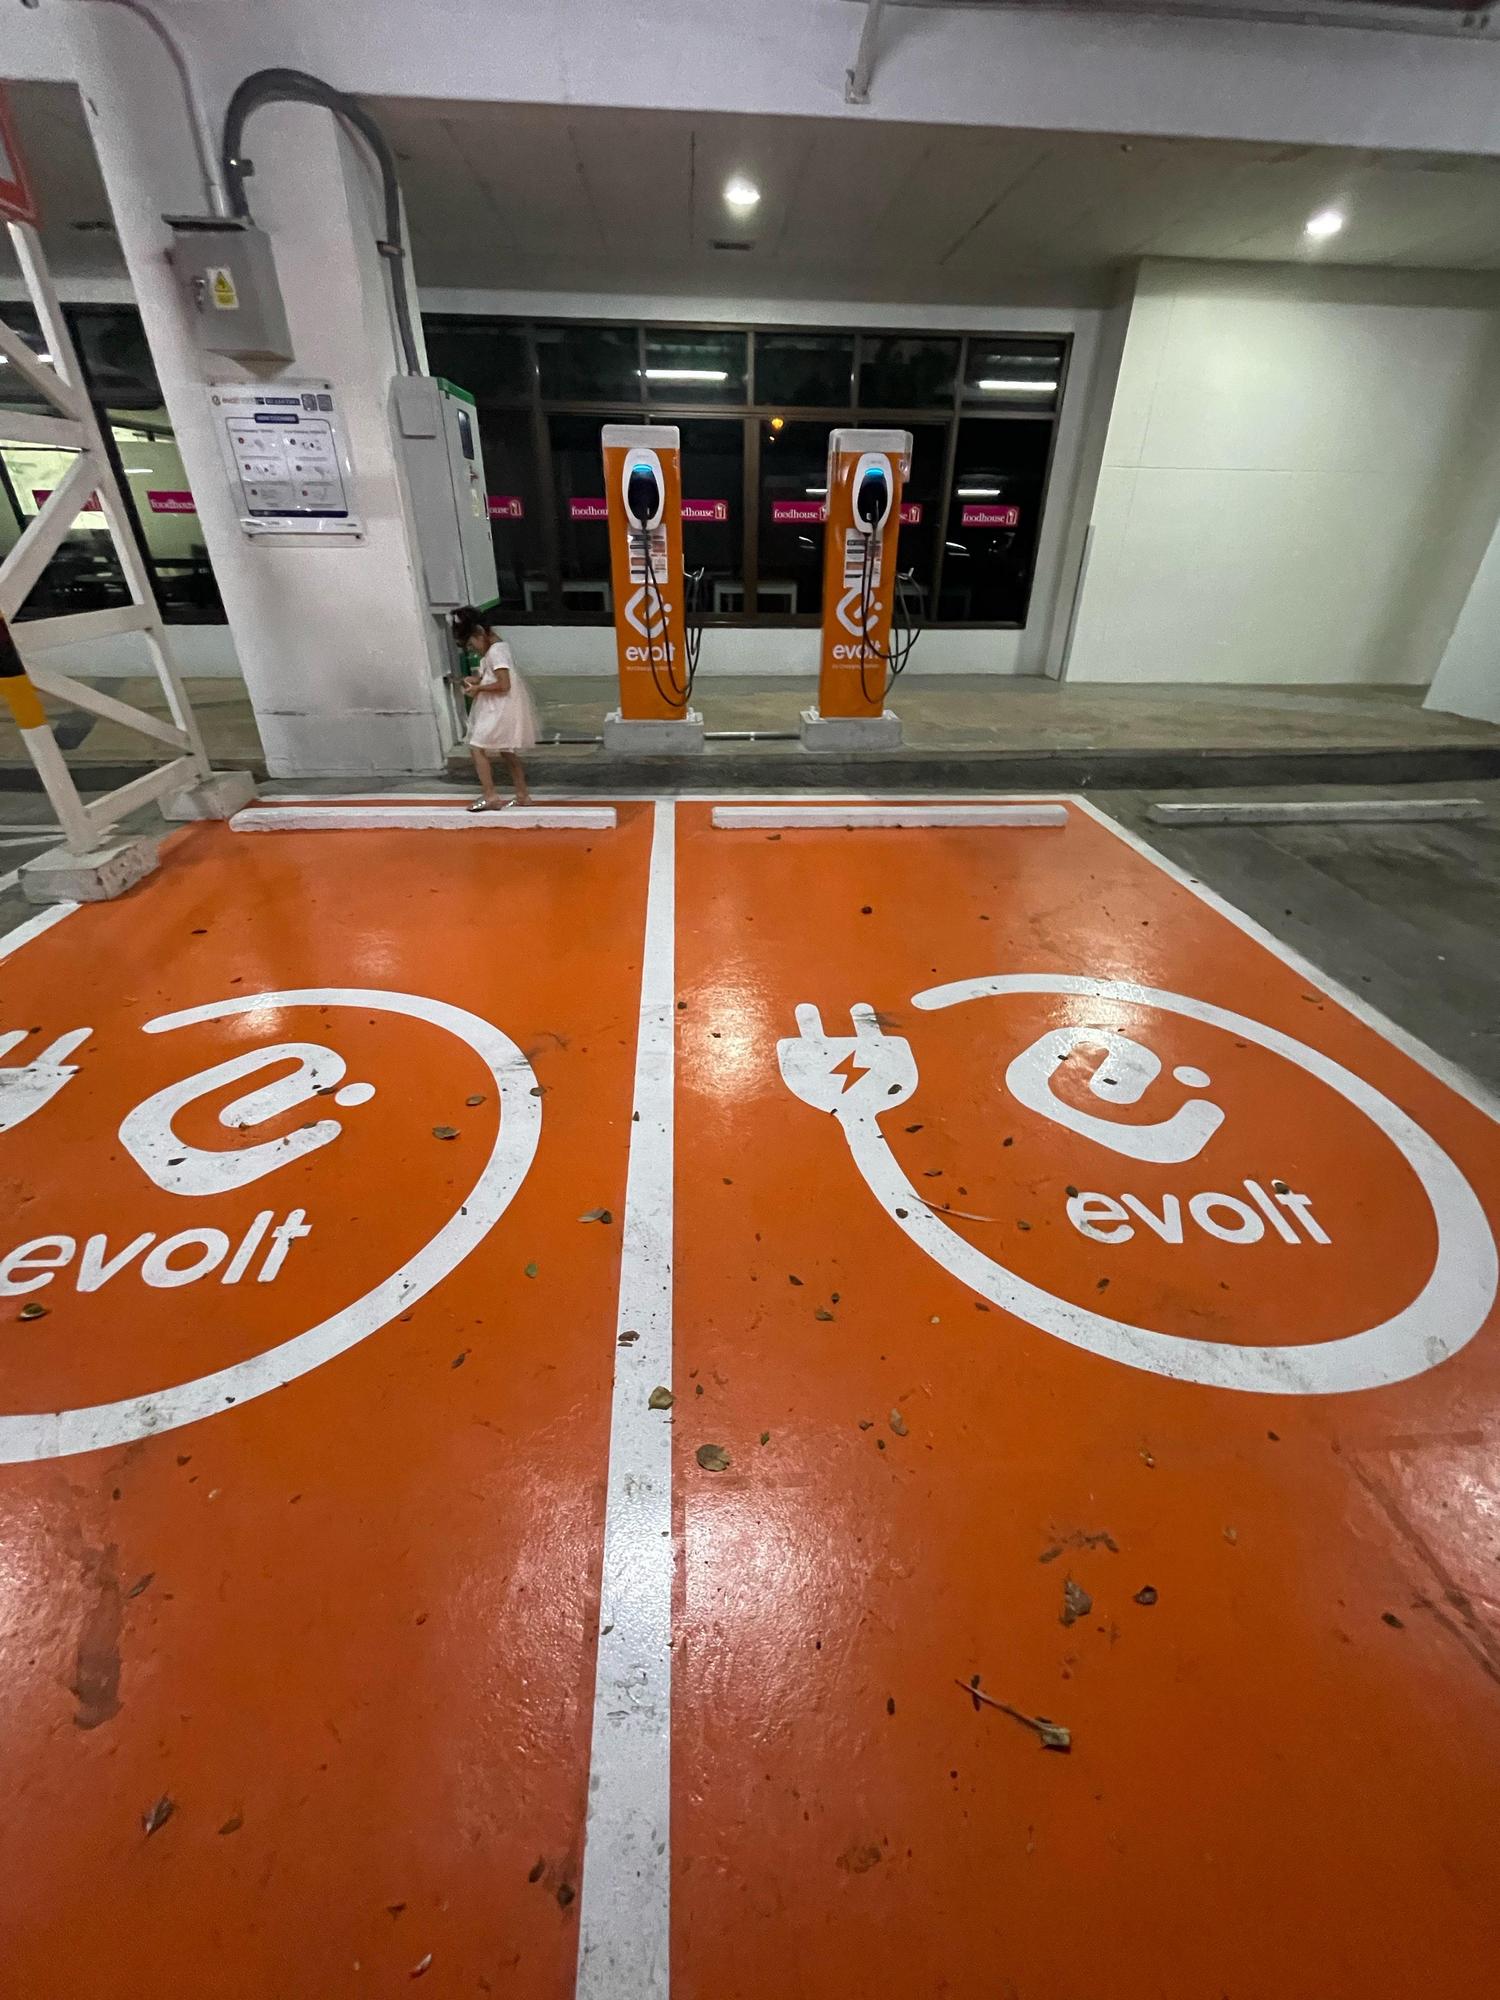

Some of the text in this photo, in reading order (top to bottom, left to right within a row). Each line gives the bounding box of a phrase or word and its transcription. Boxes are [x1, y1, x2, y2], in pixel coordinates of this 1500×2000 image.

[571, 506, 609, 515] foodhou
[774, 509, 818, 518] foodhouse
[963, 512, 1006, 522] foodhouse
[625, 642, 676, 661] evolt
[1066, 1179, 1332, 1243] evolt
[0, 1209, 312, 1296] evolt
